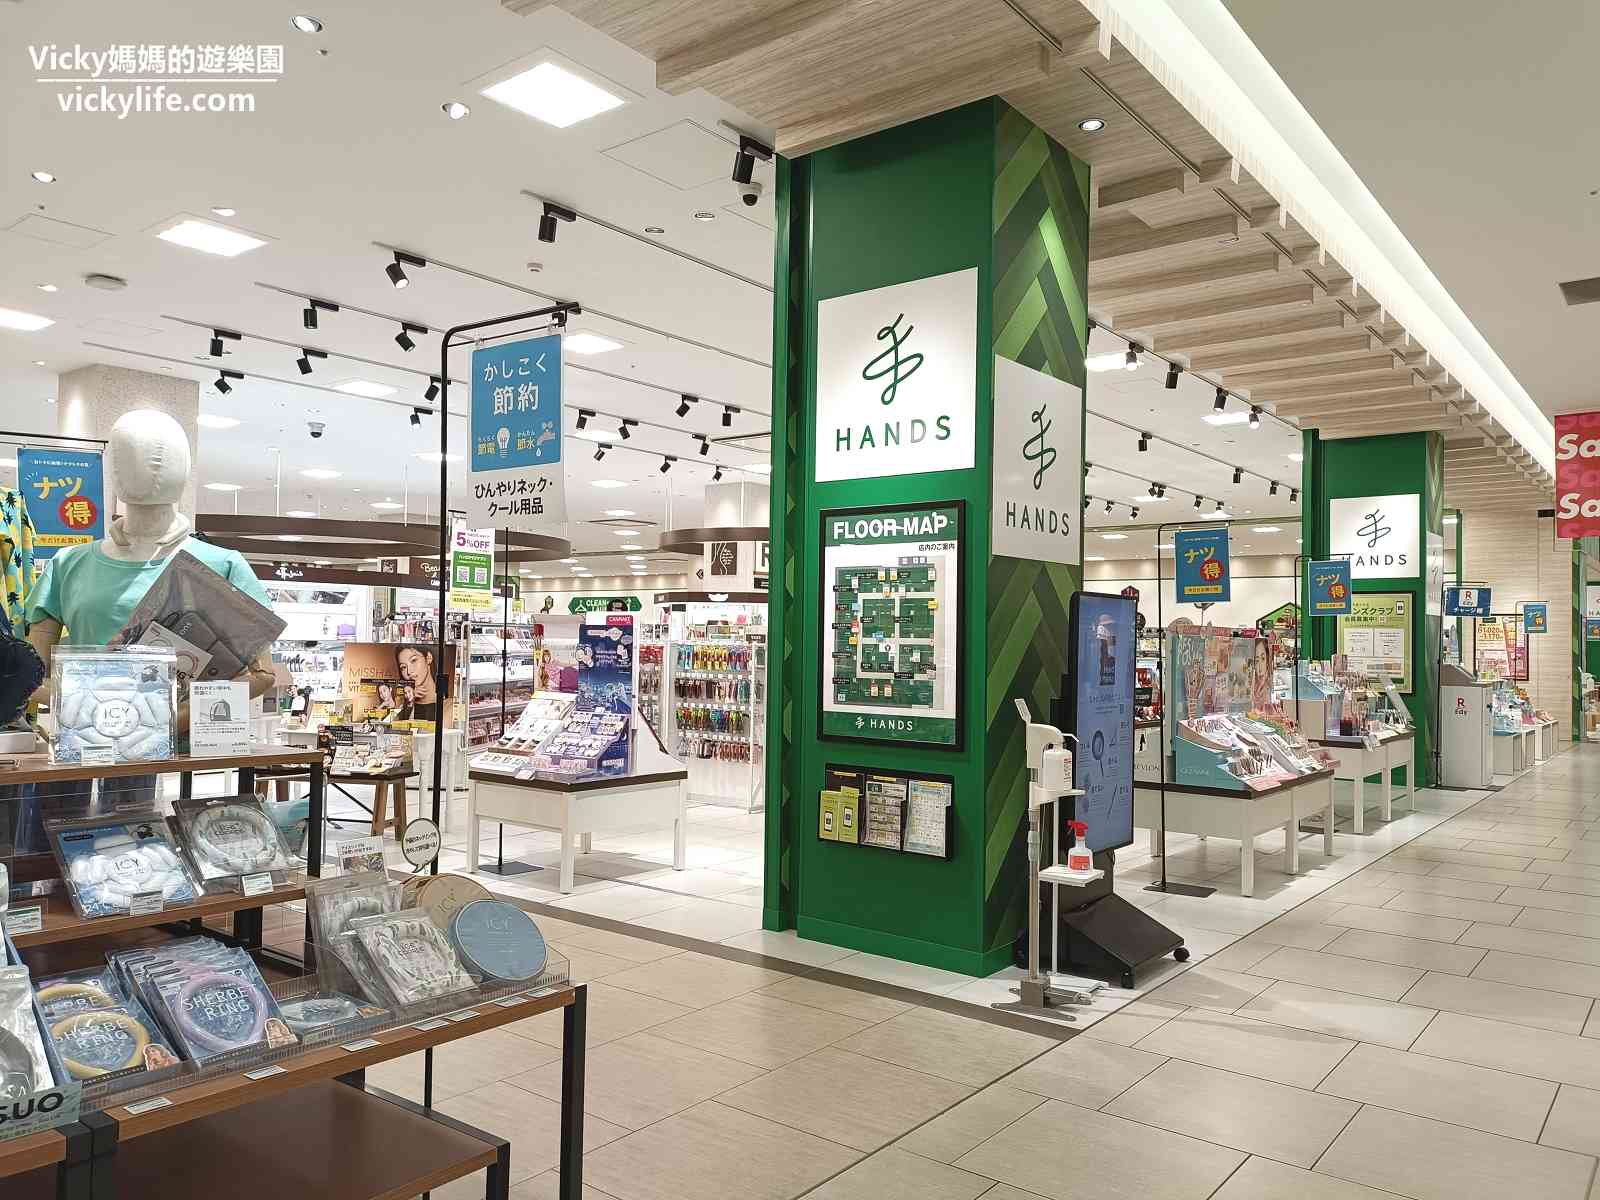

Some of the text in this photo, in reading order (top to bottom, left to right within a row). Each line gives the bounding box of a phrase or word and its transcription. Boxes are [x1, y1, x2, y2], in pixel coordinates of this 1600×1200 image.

[484, 352, 547, 383] かしこく
[492, 382, 539, 416] 節約
[836, 414, 951, 452] HANDS
[32, 475, 82, 500] ナツ
[474, 476, 553, 499] ひんやりネック・
[64, 501, 92, 526] 得
[488, 497, 544, 518] クール用品
[833, 513, 947, 539] FLOOR MAP
[1005, 501, 1070, 537] HANDS
[918, 542, 955, 552] 店内のご案内
[1184, 546, 1215, 564] ナツ
[1203, 562, 1219, 580] 得
[1316, 573, 1340, 586] ナツ
[1331, 585, 1345, 598] 得
[1353, 606, 1394, 616] ンズクラブ
[870, 718, 913, 731] HANDS
[183, 983, 257, 1011] SHERBET
[204, 999, 250, 1020] RING
